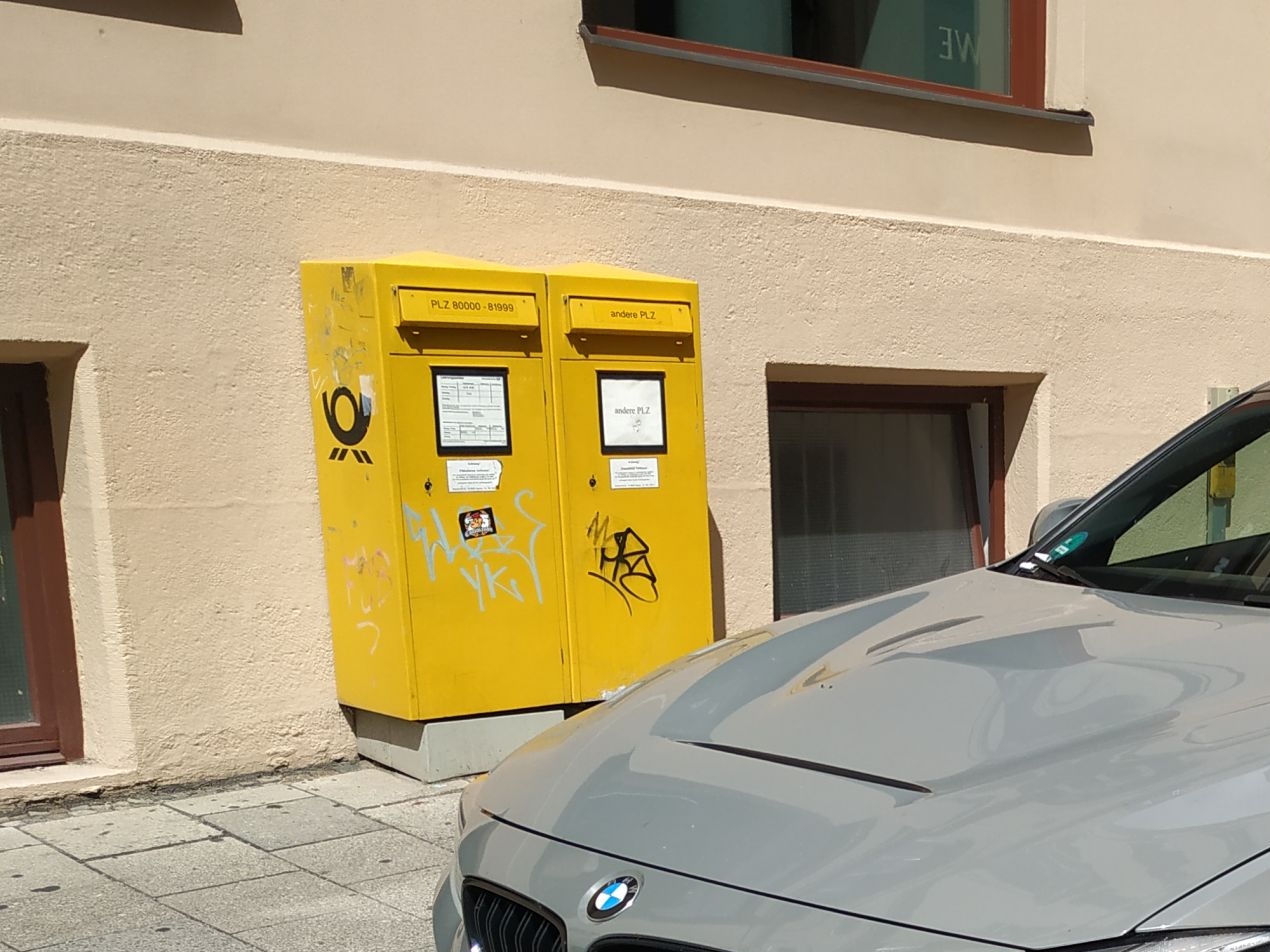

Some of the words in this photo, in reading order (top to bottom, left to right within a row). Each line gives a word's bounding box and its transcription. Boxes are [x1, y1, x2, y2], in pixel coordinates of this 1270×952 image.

[430, 299, 450, 310] PLZ
[452, 301, 481, 311] 80000
[487, 302, 514, 313] 81999
[610, 310, 638, 319] andere
[639, 310, 656, 320] PLZ
[614, 406, 636, 415] andere
[636, 406, 651, 415] PLZ
